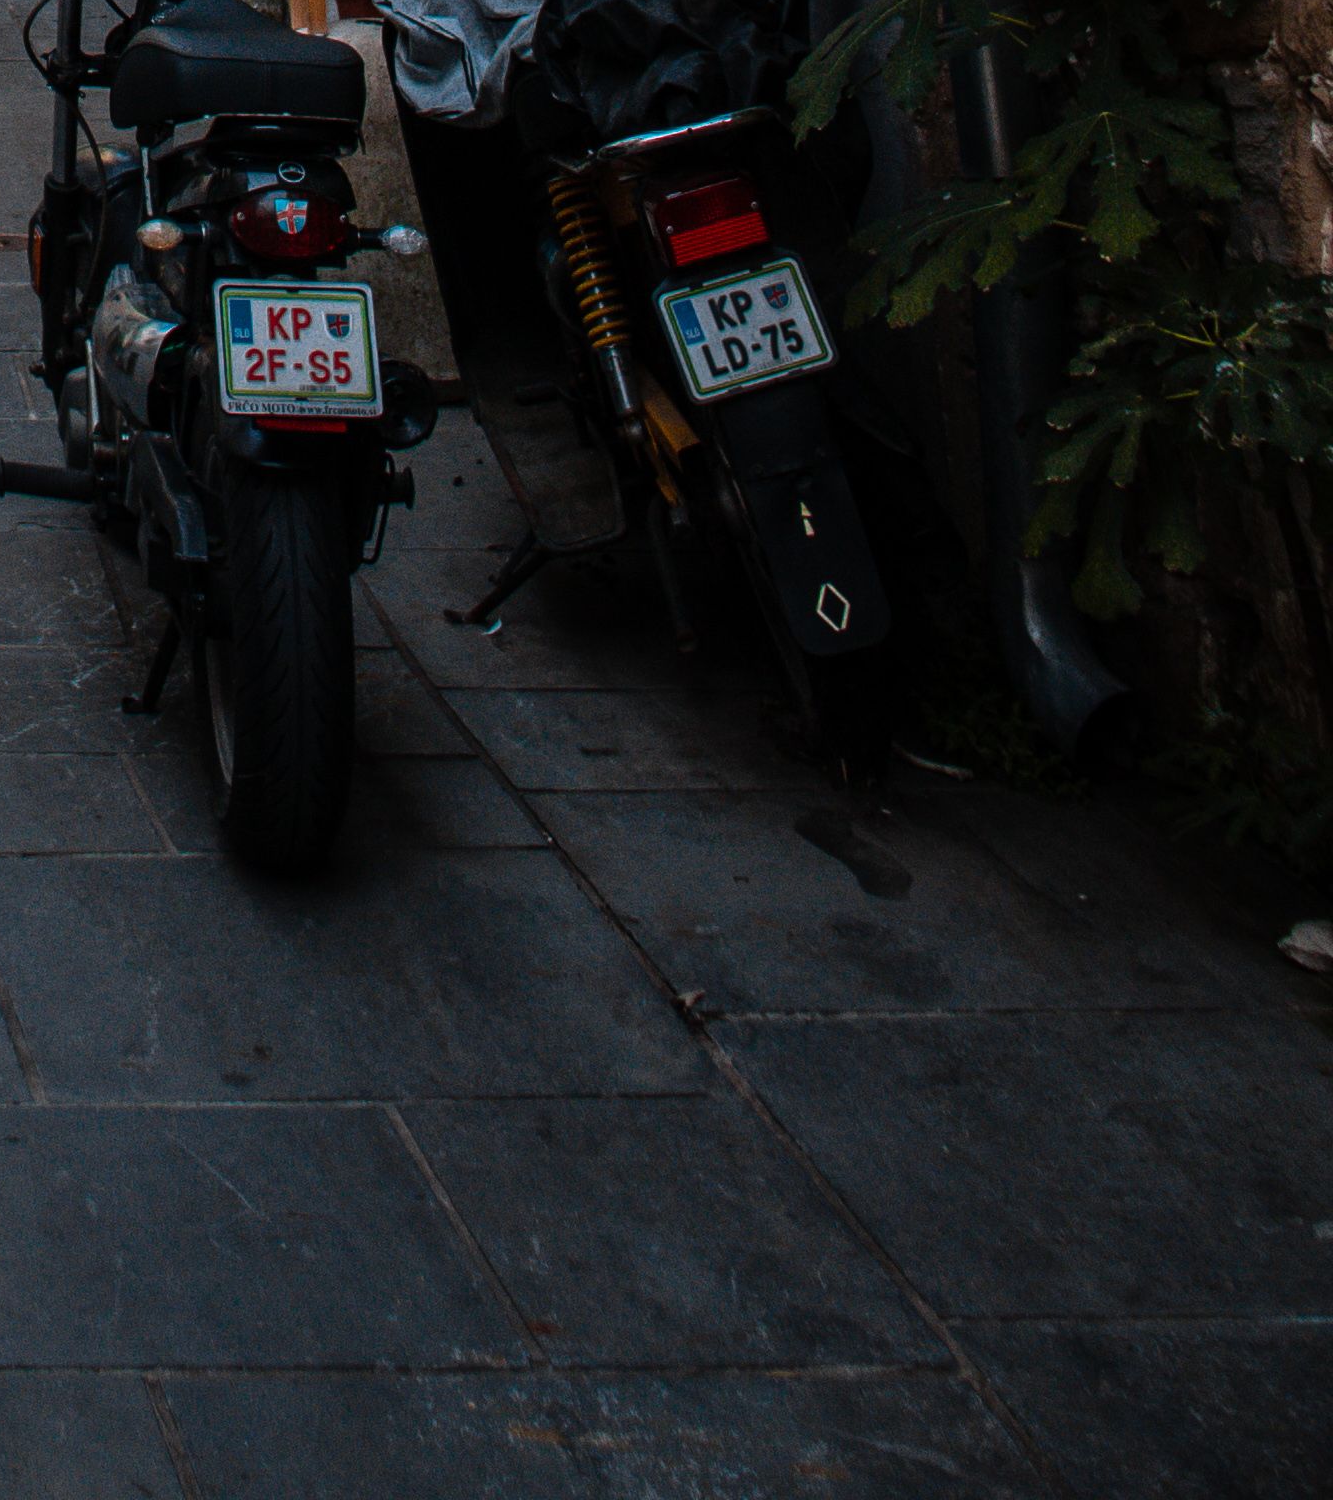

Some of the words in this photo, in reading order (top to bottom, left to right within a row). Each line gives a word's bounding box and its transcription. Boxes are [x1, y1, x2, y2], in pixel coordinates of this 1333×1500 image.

[266, 306, 312, 341] KP
[708, 290, 753, 332] KP
[234, 328, 250, 339] SLO
[701, 319, 805, 378] LD-75
[244, 348, 352, 384] 2F-S5
[262, 402, 296, 413] MOTO
